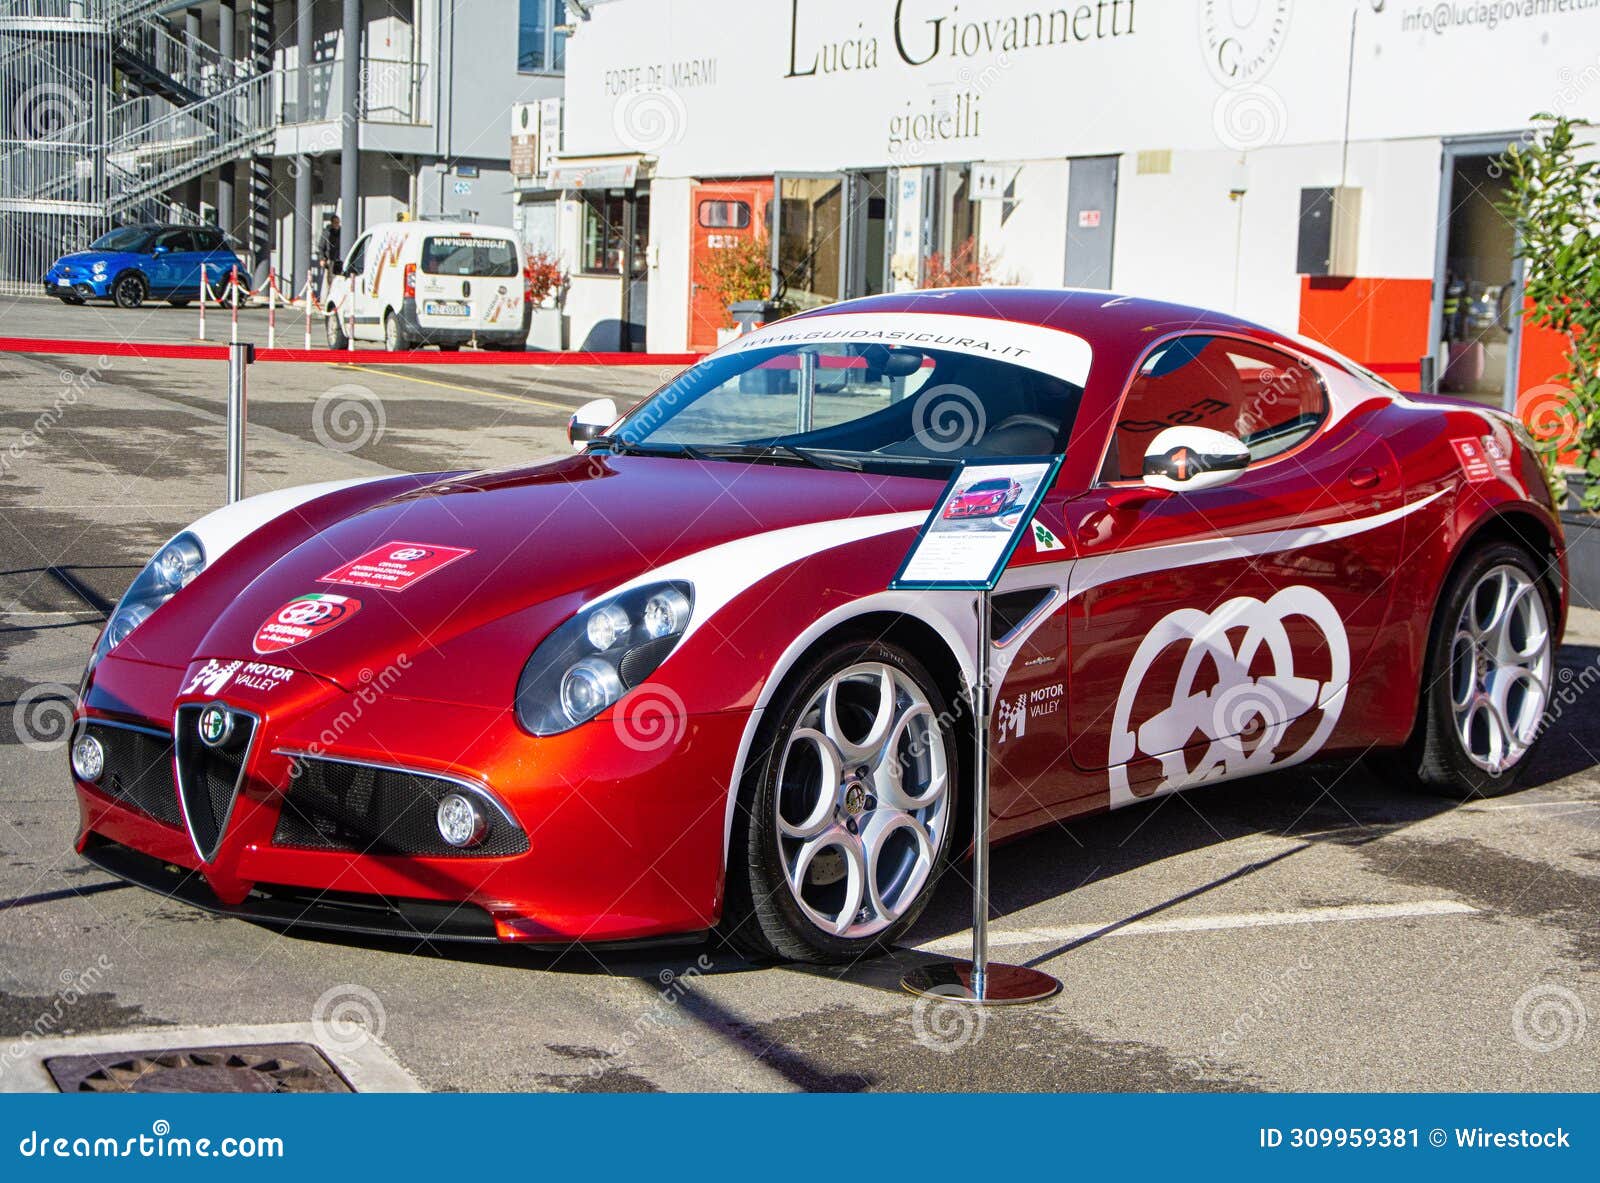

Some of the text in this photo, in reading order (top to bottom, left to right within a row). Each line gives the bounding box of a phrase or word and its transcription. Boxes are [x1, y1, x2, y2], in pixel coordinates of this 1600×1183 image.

[784, 0, 1136, 78] Lucia Giovannetti
[605, 67, 641, 95] FORTE
[672, 58, 717, 87] MARMI
[888, 92, 980, 153] gioielli
[1171, 448, 1187, 479] 1
[234, 673, 280, 692] VALLEY
[243, 662, 294, 681] MOTOR
[1030, 684, 1063, 703] MOTOR
[1030, 699, 1059, 718] VALLEY
